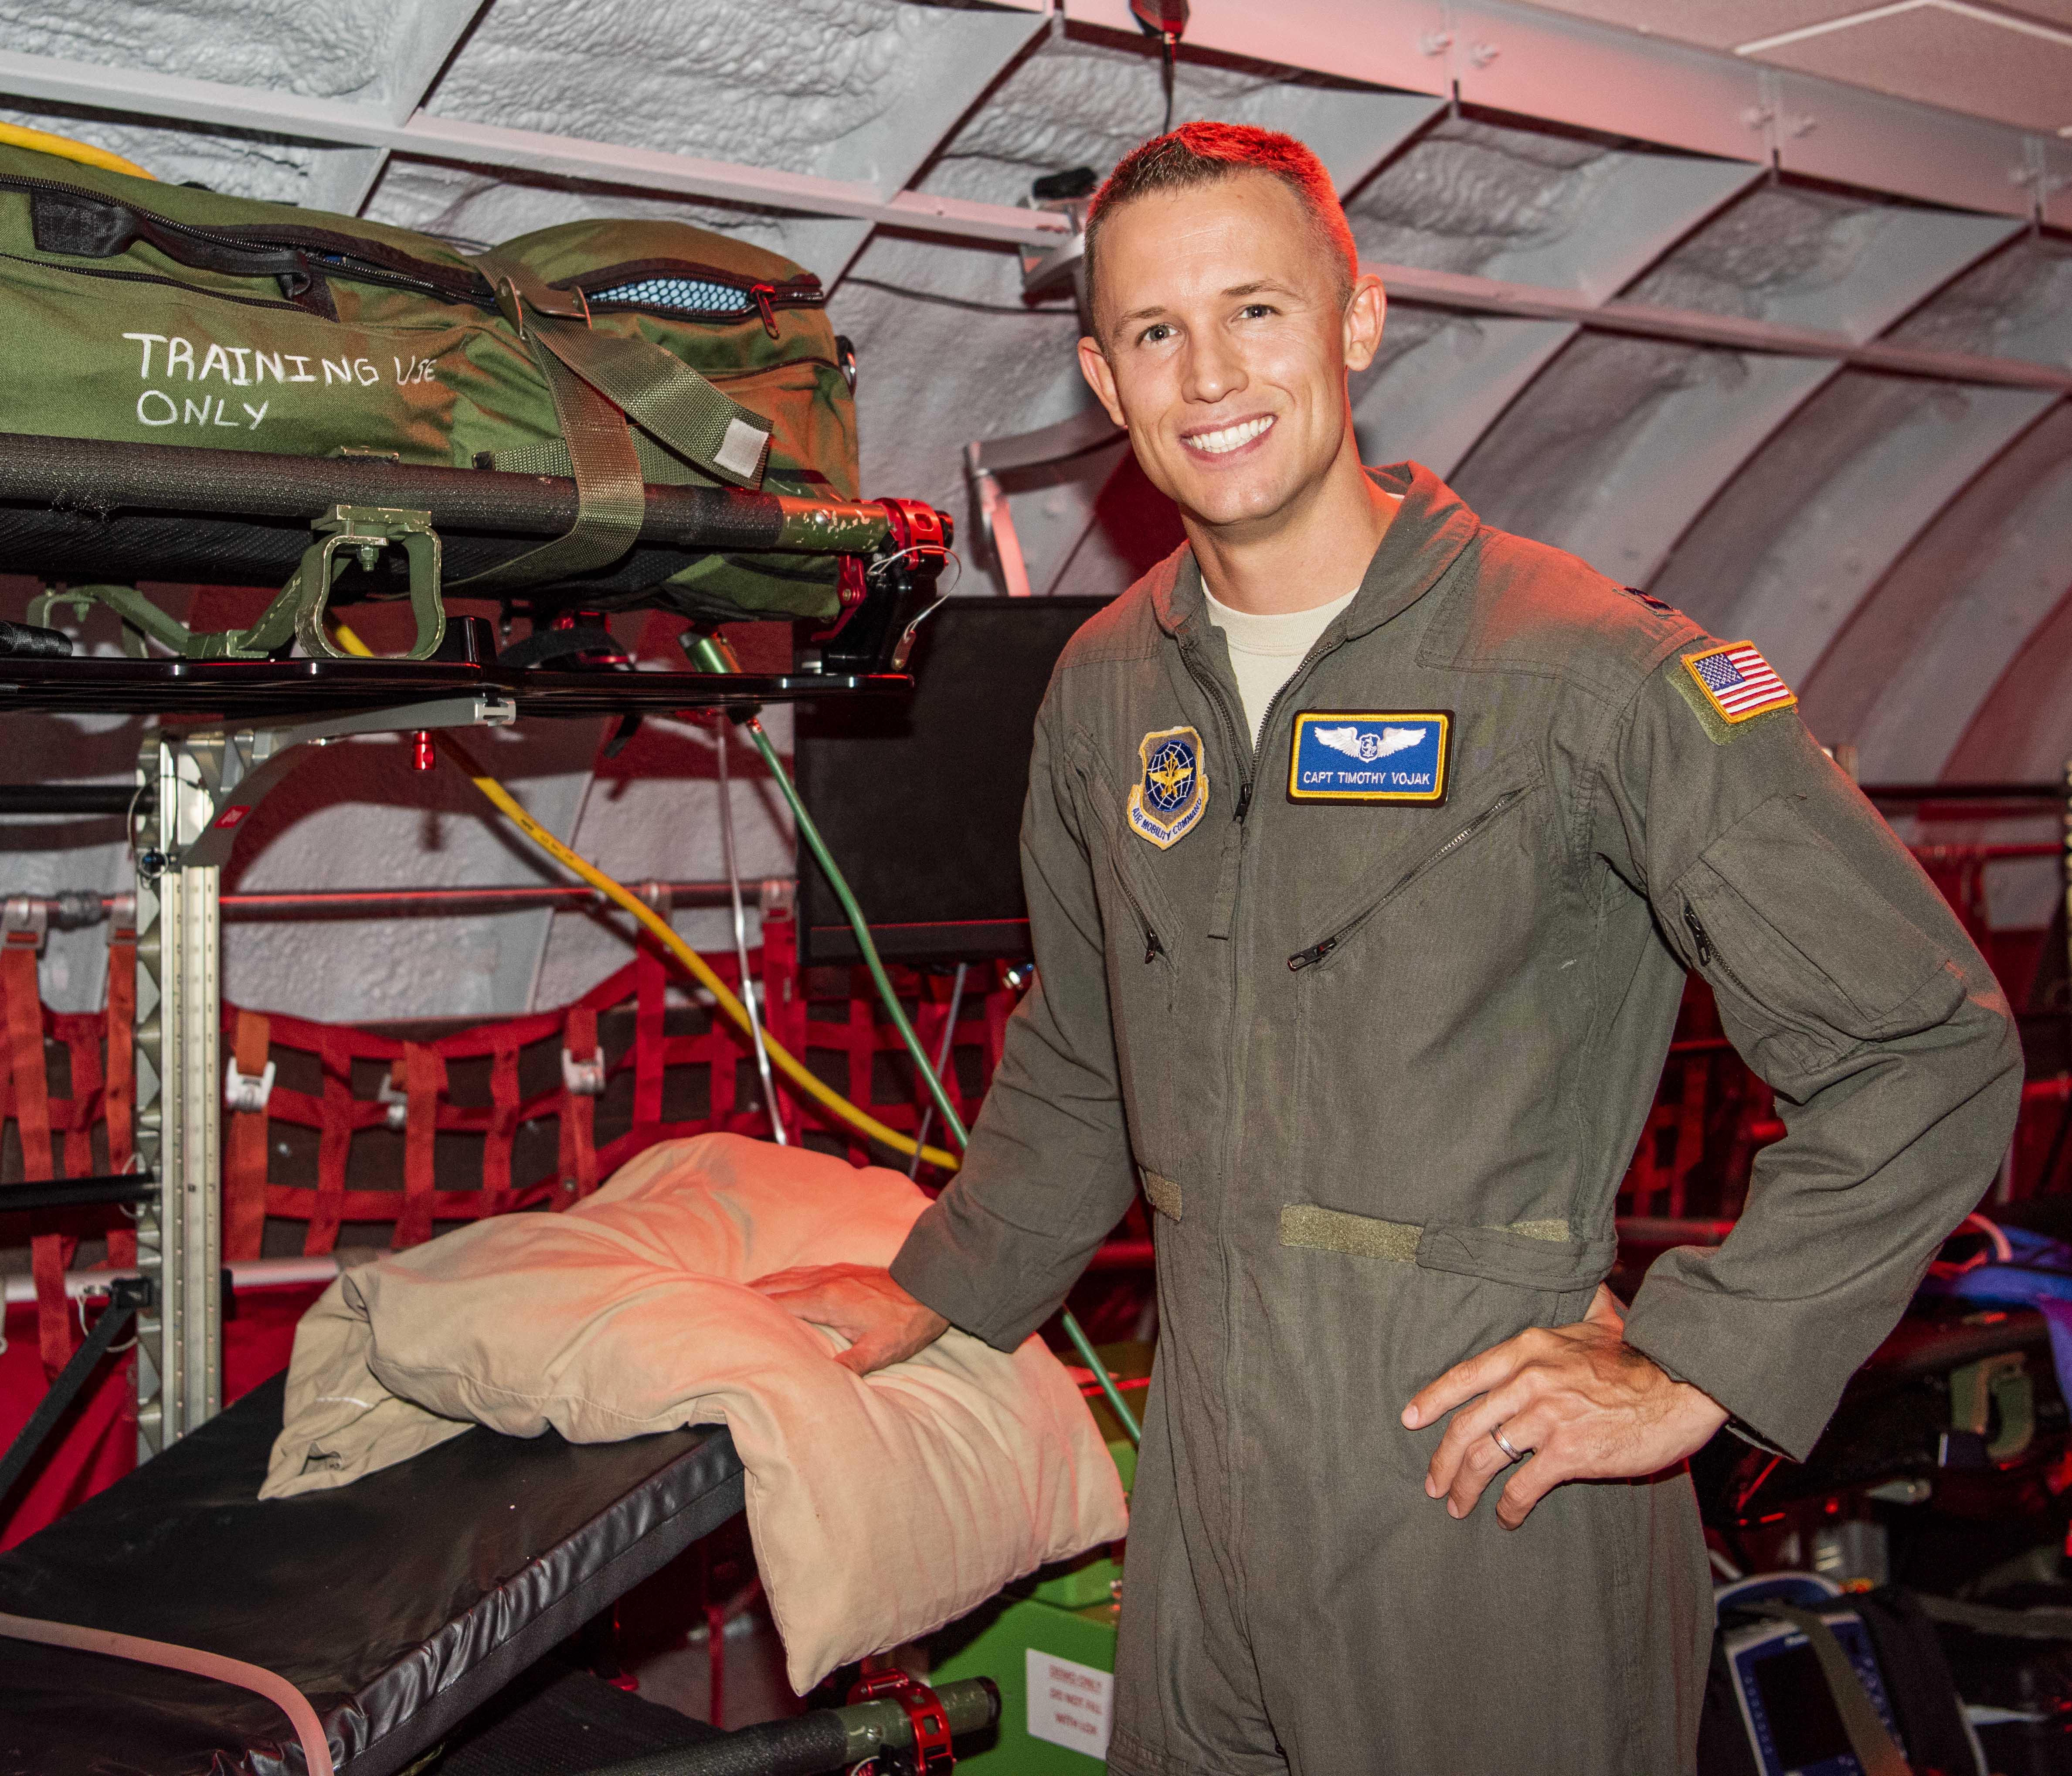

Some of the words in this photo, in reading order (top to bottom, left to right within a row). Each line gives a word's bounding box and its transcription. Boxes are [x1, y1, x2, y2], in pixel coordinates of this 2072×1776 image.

[122, 333, 379, 386] TRAINING
[394, 356, 438, 385] USE
[137, 390, 268, 431] ONLY
[1304, 771, 1333, 784] CAPT
[1338, 772, 1386, 784] TIMOTHY
[1392, 772, 1430, 785] VOJAK
[1133, 807, 1143, 824] AIR
[1141, 819, 1171, 841] MOBILITY
[1173, 798, 1202, 835] COMMAND
